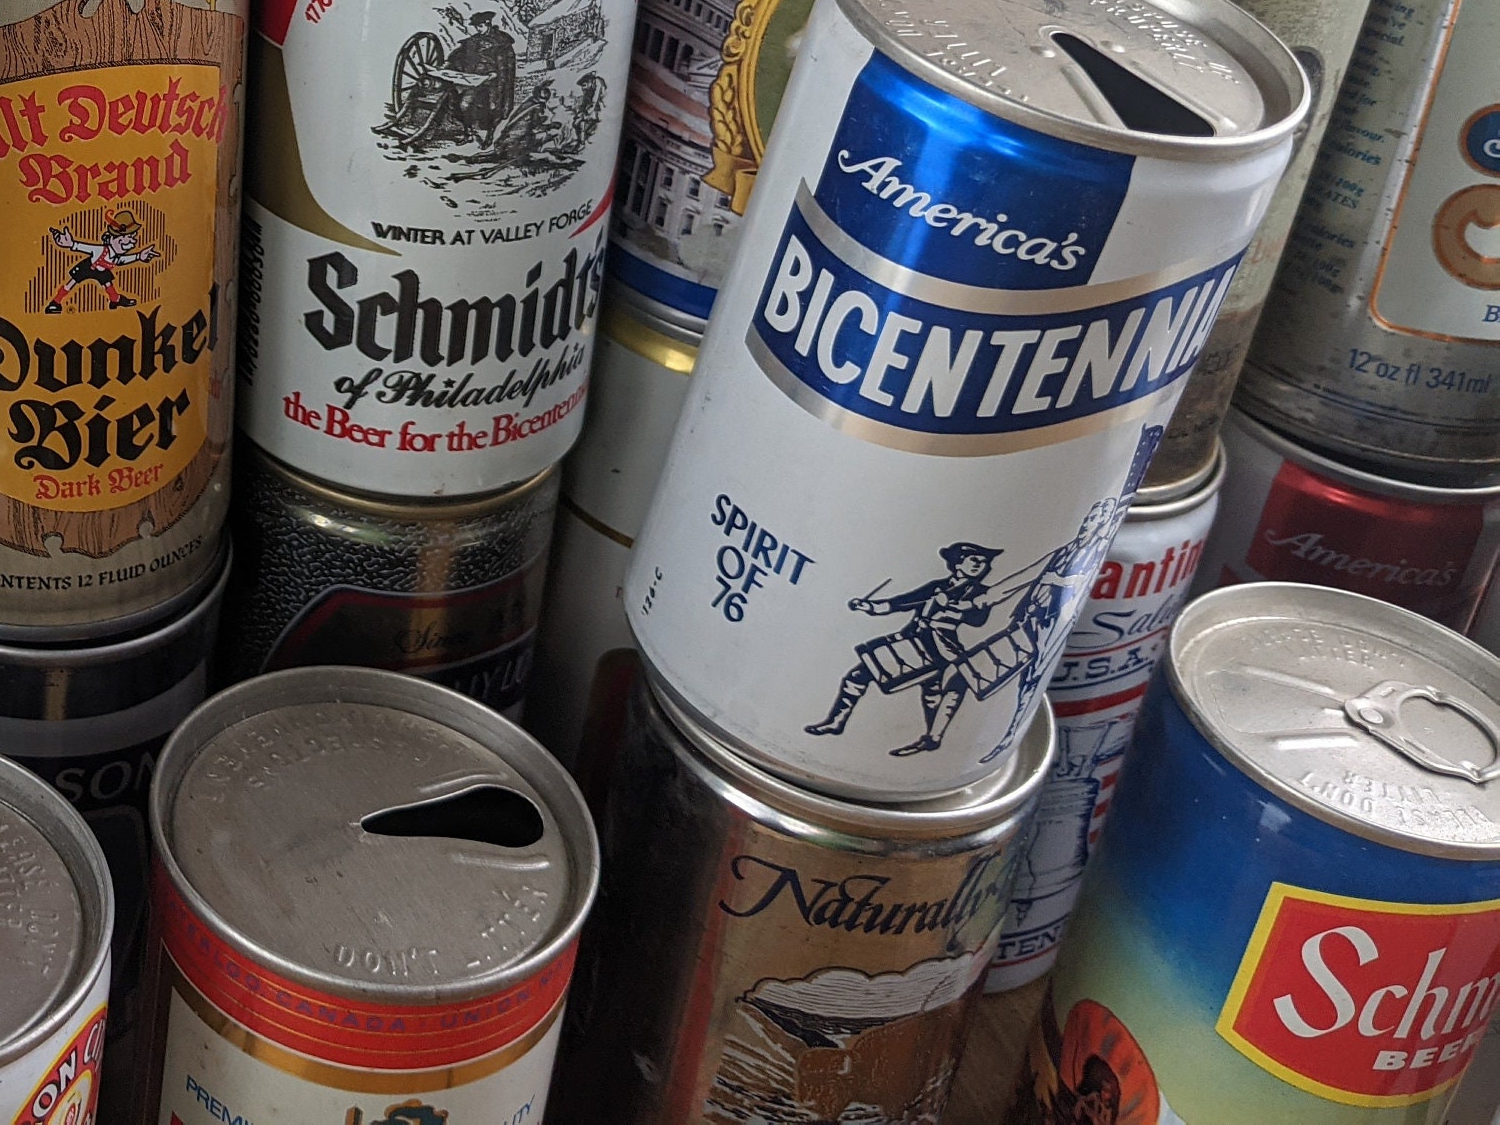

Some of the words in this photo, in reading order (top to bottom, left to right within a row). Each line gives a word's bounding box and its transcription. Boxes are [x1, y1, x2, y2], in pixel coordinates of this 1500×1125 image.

[57, 75, 229, 146] Deutsch
[17, 137, 193, 207] Brand
[370, 221, 446, 246] WINTER
[449, 229, 474, 246] AT
[479, 220, 544, 245] VALLEY
[547, 198, 595, 233] FORGE
[837, 147, 1089, 273] America's
[302, 225, 605, 369] Schmidt's
[763, 234, 1237, 419] BICENTENNIA
[333, 367, 382, 411] of
[375, 341, 587, 410] Philadelphia
[1348, 347, 1374, 375] 12
[7, 387, 192, 472] Bier
[282, 391, 323, 431] the
[323, 403, 391, 449] Beer
[396, 421, 443, 453] for
[446, 424, 489, 453] the
[33, 473, 102, 502] Dark
[108, 463, 165, 494] Beer
[77, 572, 93, 588] 12
[98, 562, 146, 585] FLUID
[149, 535, 204, 573] OUNCES
[709, 492, 818, 588] SPIRIT
[716, 543, 766, 594] OF
[1090, 539, 1207, 600] antin
[1264, 527, 1459, 589] America's
[708, 578, 746, 624] 76
[276, 991, 408, 1034] CANADA
[1273, 925, 1500, 1041] Schm
[1372, 1030, 1484, 1072] BEER
